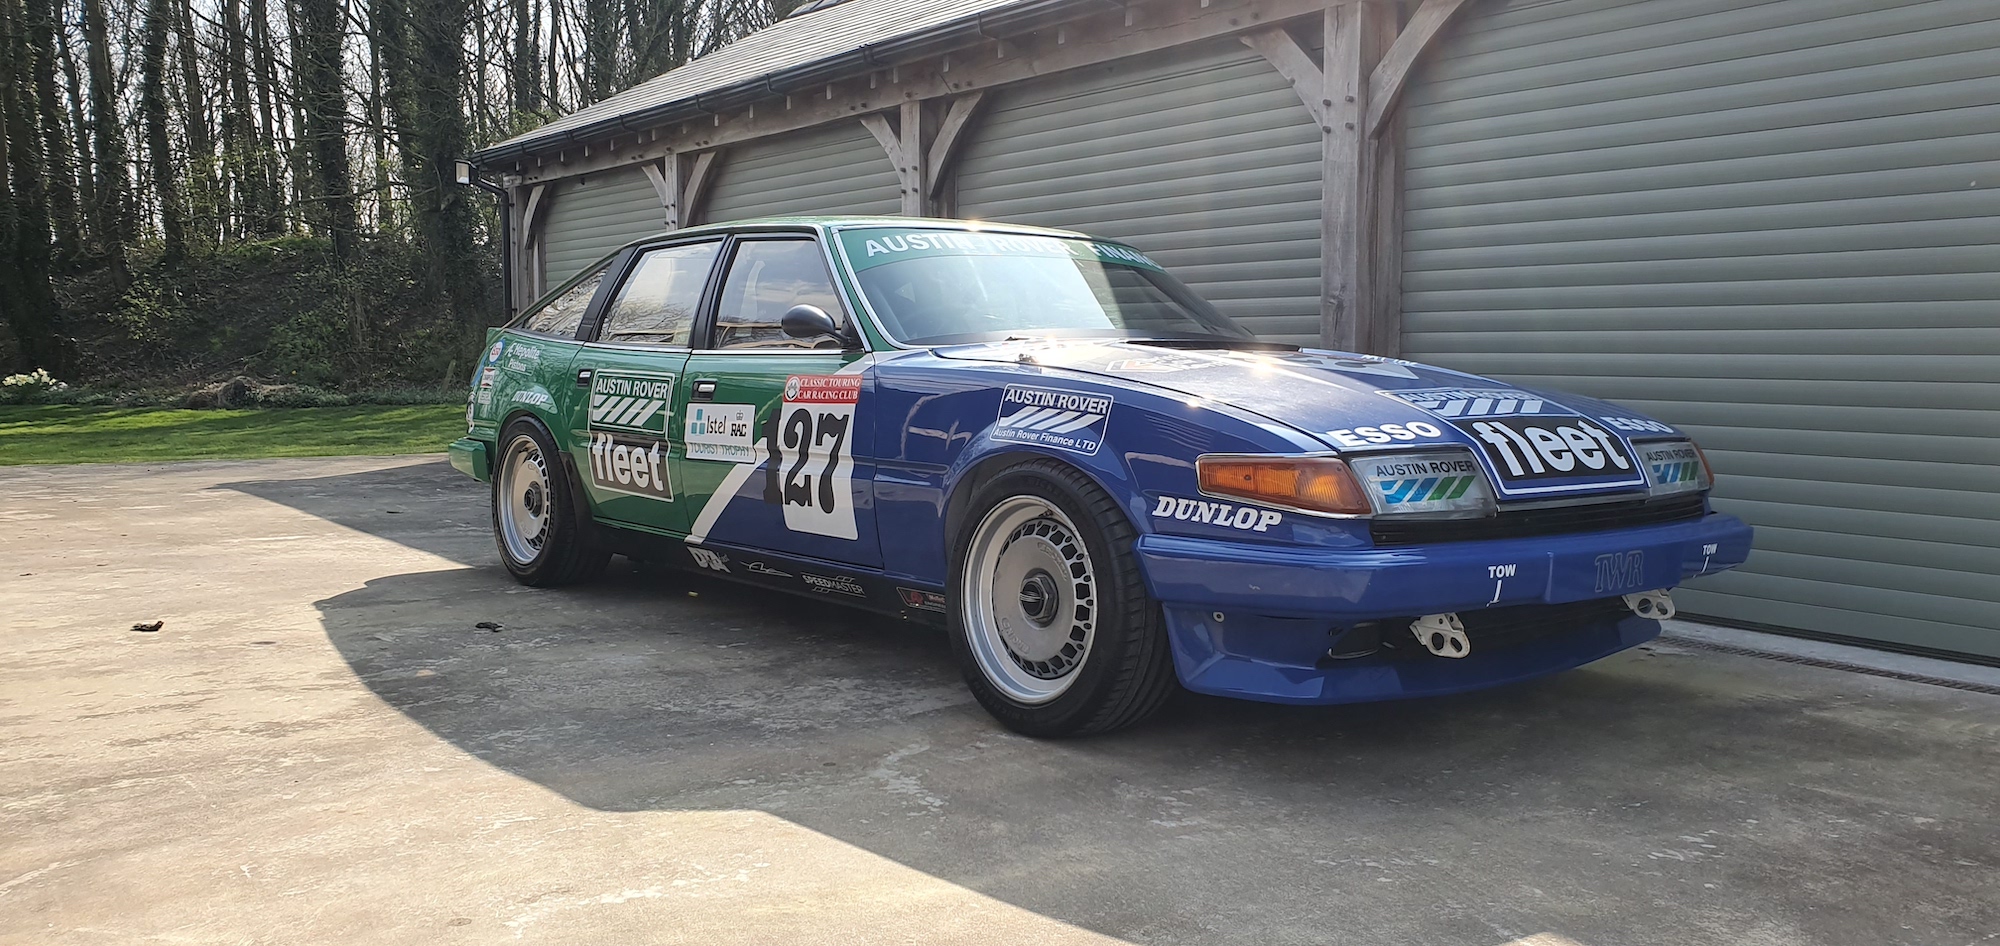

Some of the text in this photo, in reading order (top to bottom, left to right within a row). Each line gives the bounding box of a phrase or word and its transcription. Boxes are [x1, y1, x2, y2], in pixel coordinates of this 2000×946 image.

[865, 232, 979, 258] AUSTIN
[508, 358, 527, 371] Pistons
[595, 378, 669, 399] AUSTIN ROVER
[800, 378, 861, 387] CLASSIC TOURING
[511, 390, 549, 406] DUNLOP
[798, 390, 858, 400] CAR RACING CLUB
[1005, 388, 1110, 414] AUSTIN ROVER
[1398, 390, 1476, 402] AUSTIN
[706, 415, 747, 437] Istel RAC
[1326, 421, 1443, 447] ESSO
[1599, 416, 1674, 433] ESSO
[690, 442, 750, 457] TOURIST TROPHY
[993, 428, 1096, 451] Austin Rover Finance LTD
[1472, 420, 1629, 477] fleet
[592, 432, 665, 491] fleet
[761, 408, 850, 514] 127
[1646, 448, 1698, 462] AUSTIN ROVER
[1376, 460, 1477, 477] AUSTIN ROVER
[1151, 495, 1283, 533] DUNLOP
[1702, 543, 1718, 556] TOW
[1488, 563, 1517, 579] TOW
[1594, 550, 1645, 593] TWR
[802, 575, 866, 595] SPEEDMASTER
